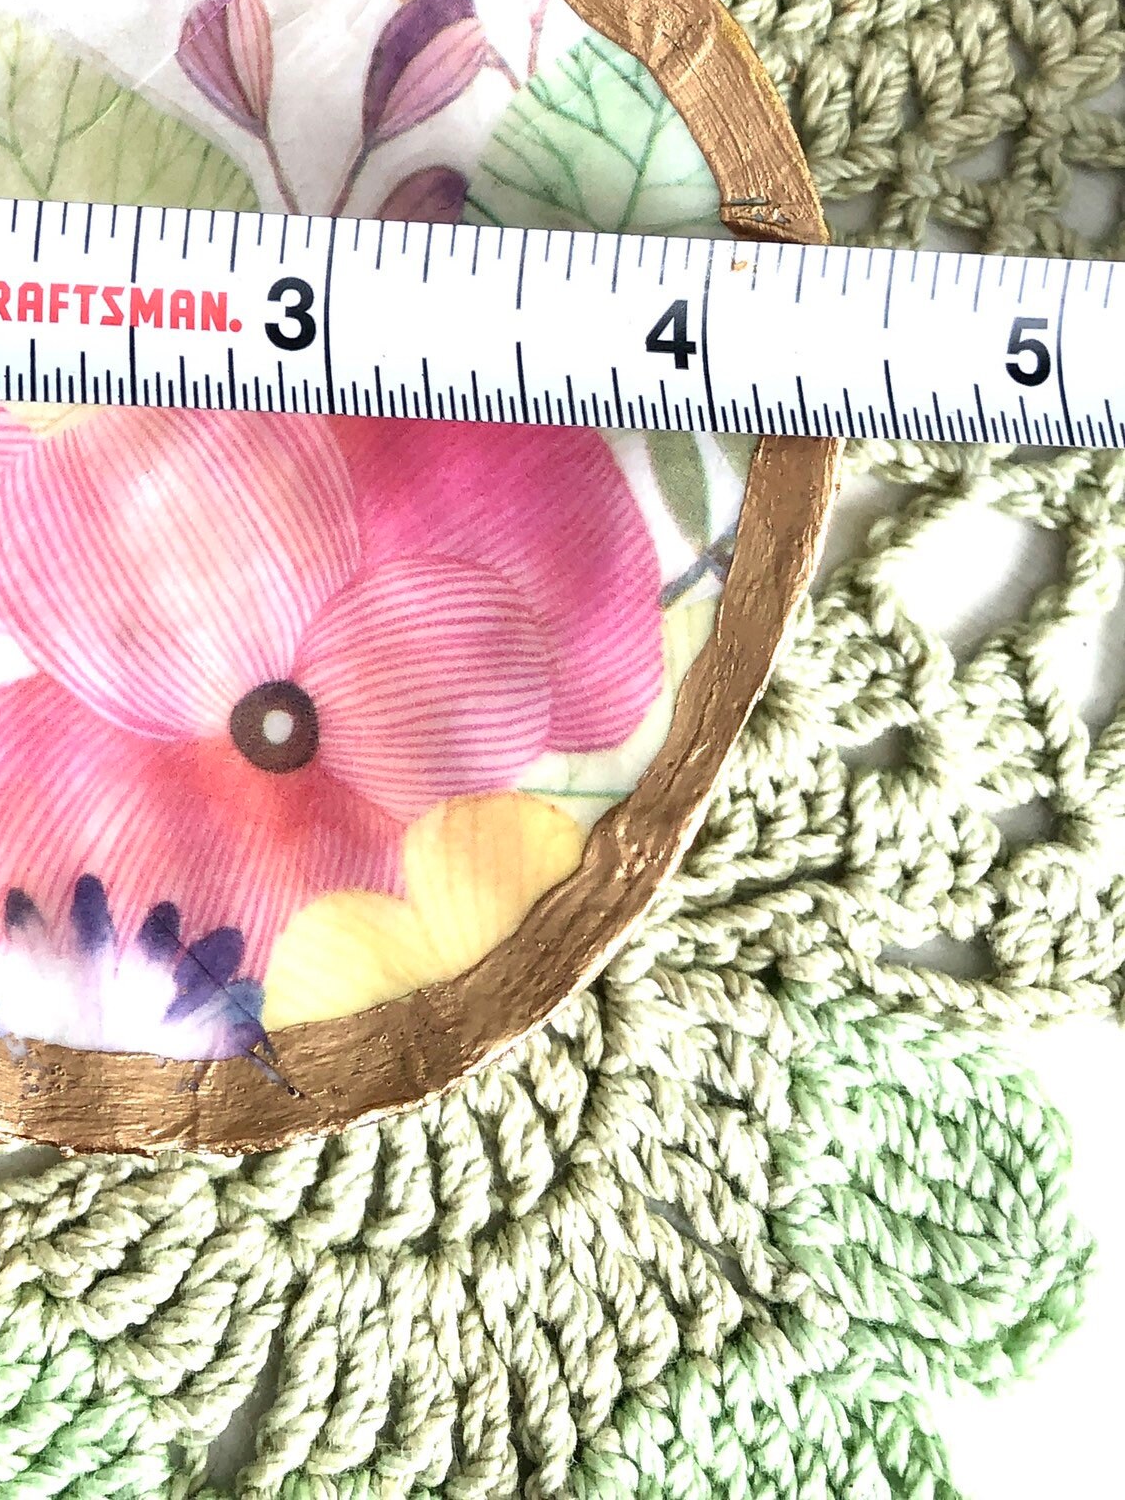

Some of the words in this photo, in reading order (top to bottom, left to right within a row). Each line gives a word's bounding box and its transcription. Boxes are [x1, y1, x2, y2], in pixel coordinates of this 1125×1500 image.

[264, 277, 317, 352] 3
[645, 299, 697, 370] 4
[1005, 316, 1051, 387] 5
